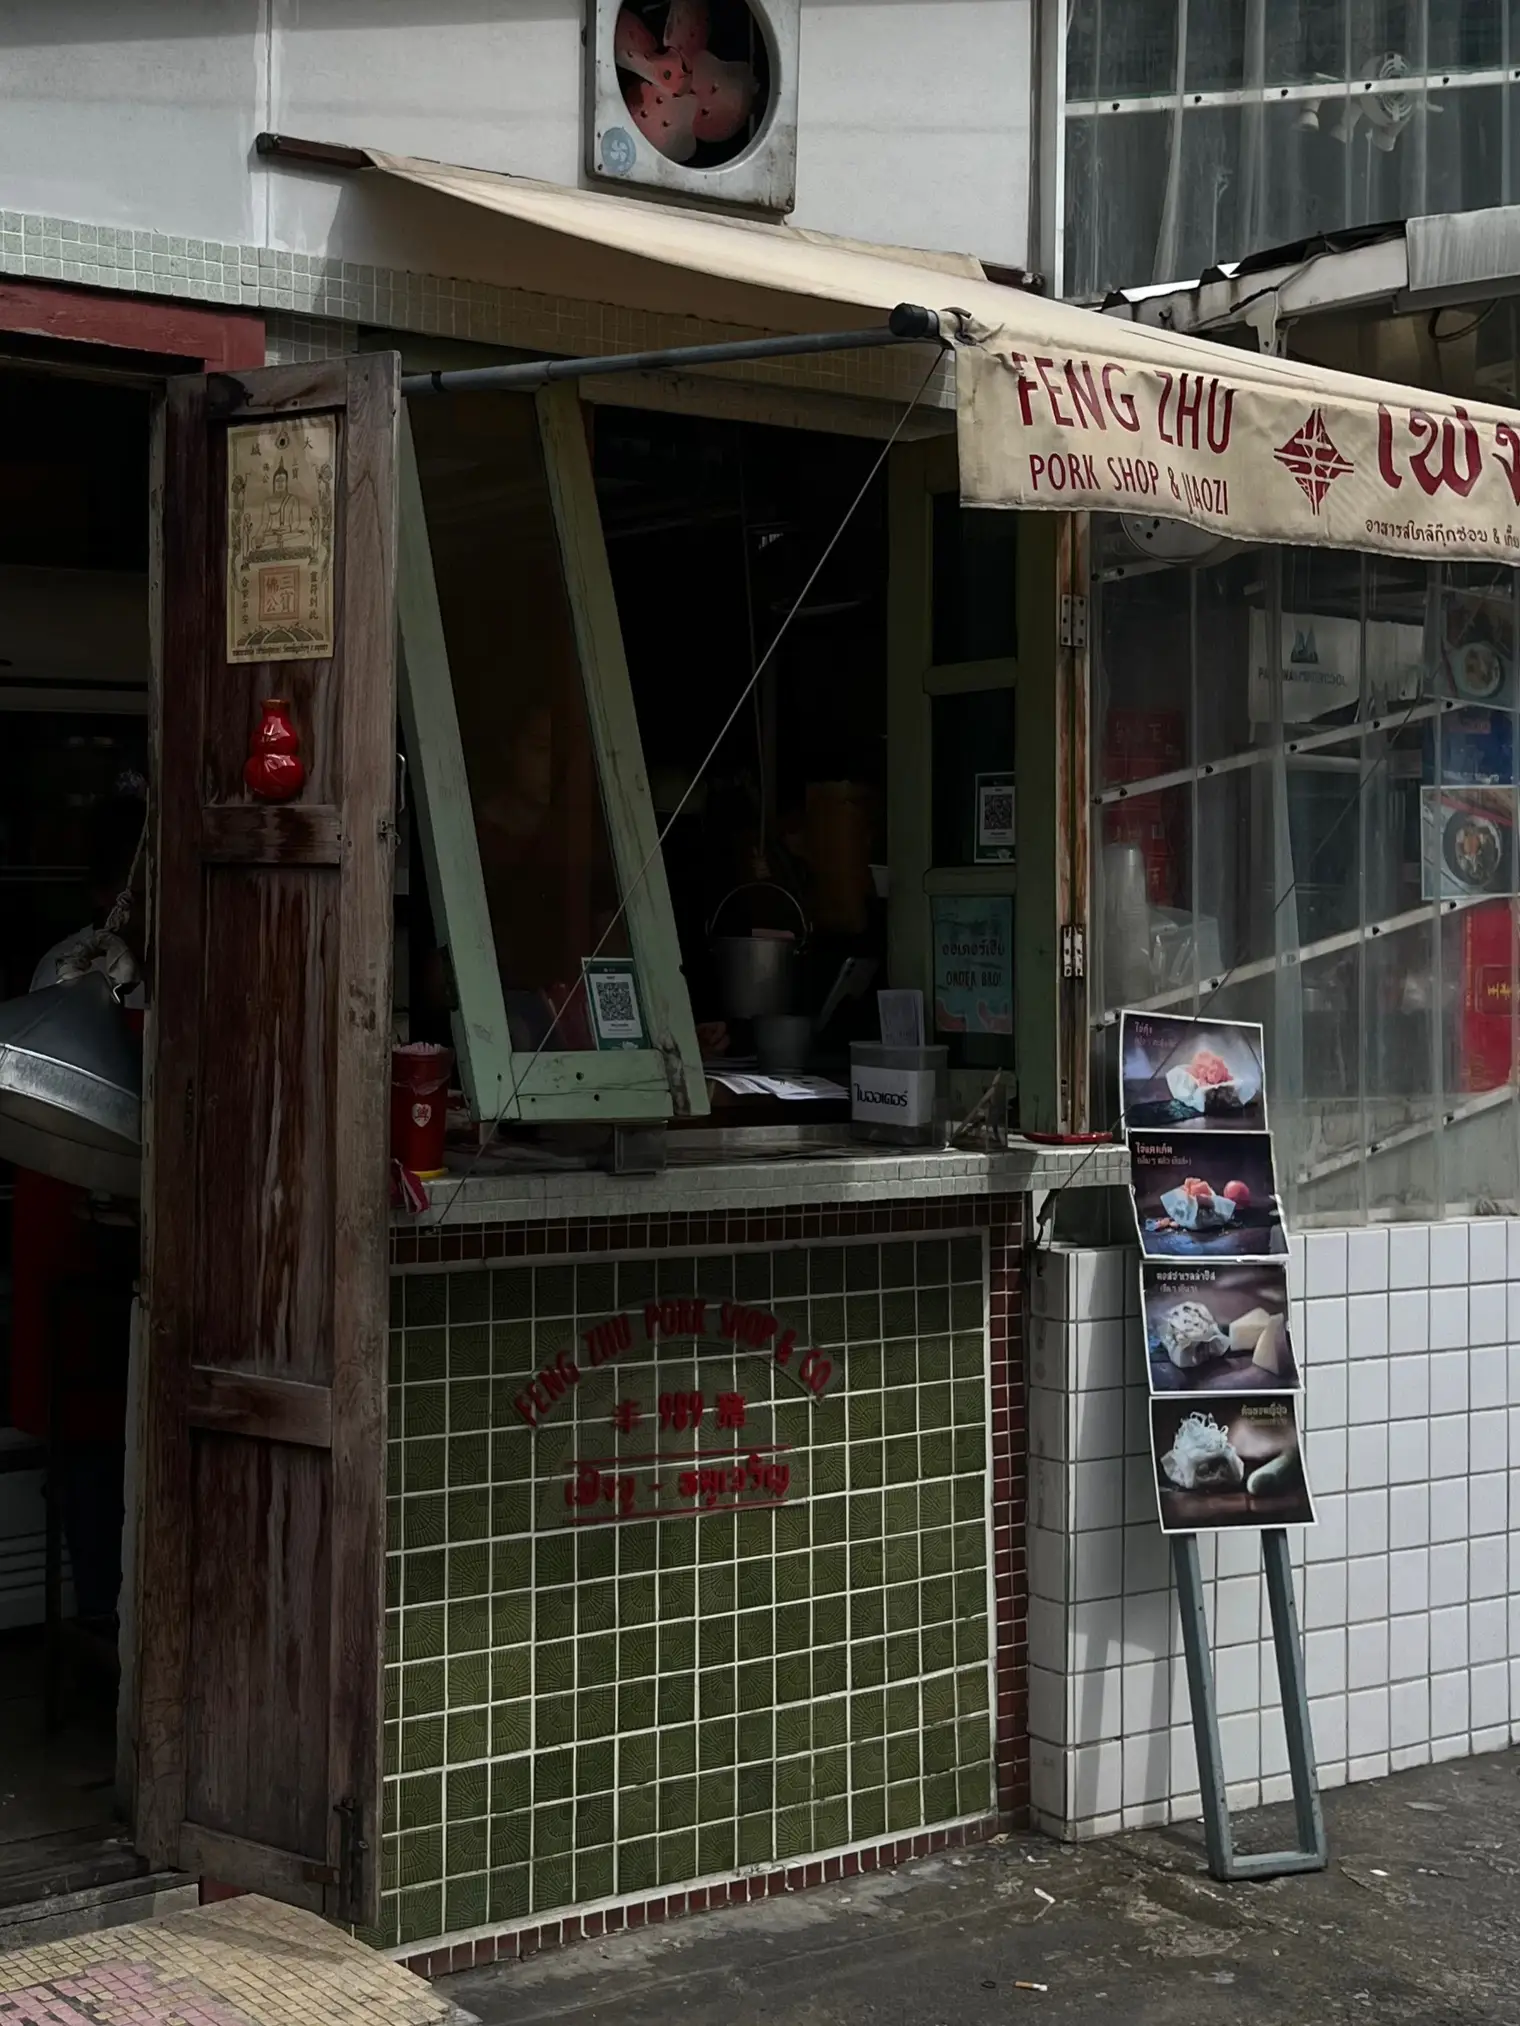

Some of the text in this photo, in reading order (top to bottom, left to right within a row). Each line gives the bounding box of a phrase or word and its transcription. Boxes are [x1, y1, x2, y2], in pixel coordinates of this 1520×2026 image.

[1011, 351, 1237, 454] FENG ZHU
[1030, 453, 1229, 515] PORK SHOP & JIAOZI
[1493, 527, 1502, 546] &
[853, 1082, 909, 1107] ใบออเดอร์
